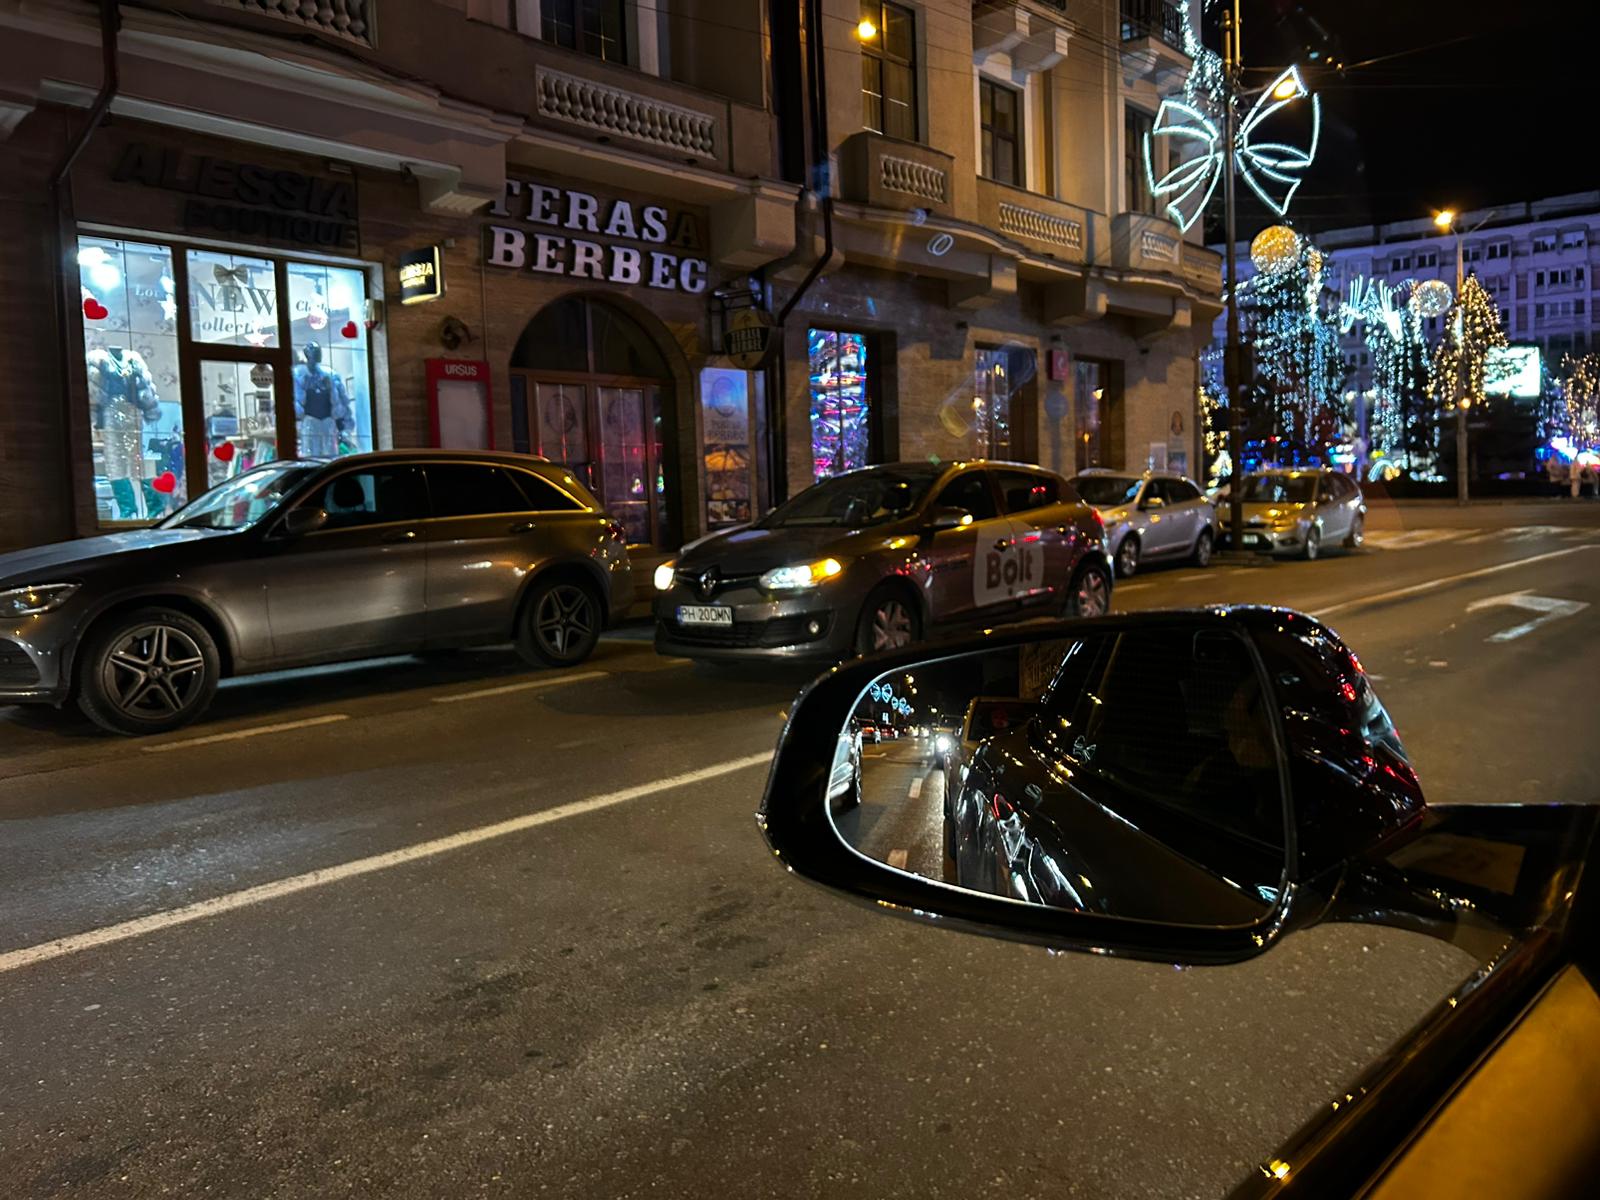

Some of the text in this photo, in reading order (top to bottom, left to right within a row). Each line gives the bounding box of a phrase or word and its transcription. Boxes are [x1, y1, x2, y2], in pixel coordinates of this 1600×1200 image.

[111, 143, 355, 219] ALESSIA
[184, 199, 358, 248] BOUTIQUE
[489, 178, 703, 249] TERASA
[488, 225, 709, 294] BERBEC
[191, 281, 276, 316] NEW
[444, 363, 478, 377] URSUS
[986, 548, 1033, 591] Bolt
[680, 606, 696, 621] PH
